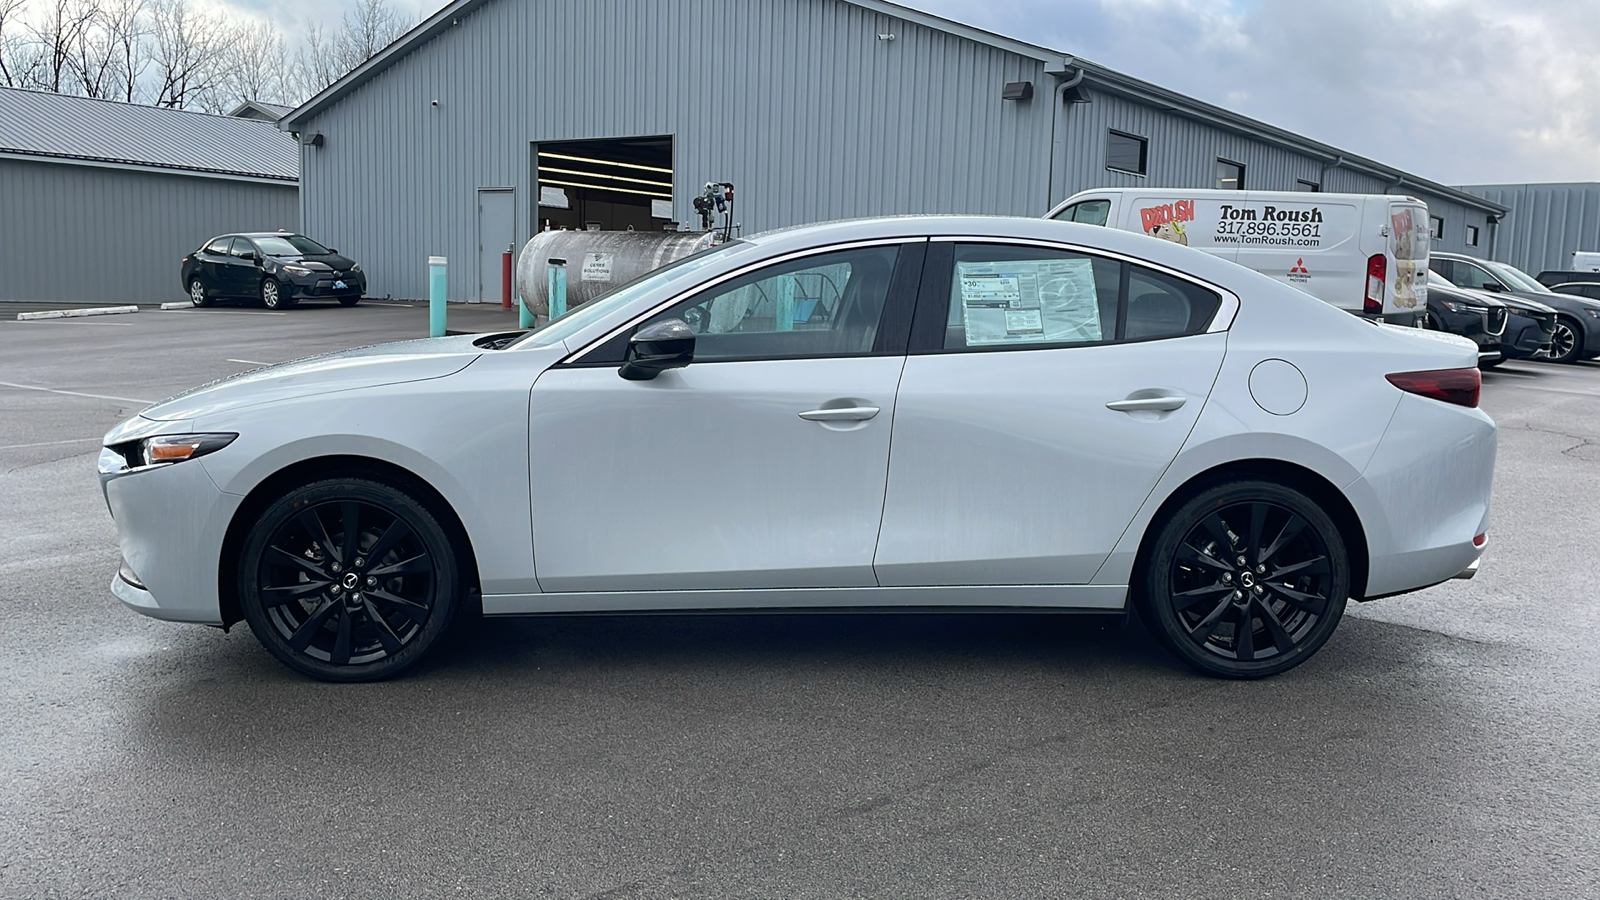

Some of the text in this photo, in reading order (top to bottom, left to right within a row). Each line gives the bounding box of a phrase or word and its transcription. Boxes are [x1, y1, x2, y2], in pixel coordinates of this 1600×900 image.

[1220, 205, 1323, 223] Tom Roush
[1216, 221, 1321, 237] 317.896.5561
[1213, 235, 1320, 247] www.TomRoush.com
[967, 280, 977, 288] 30
